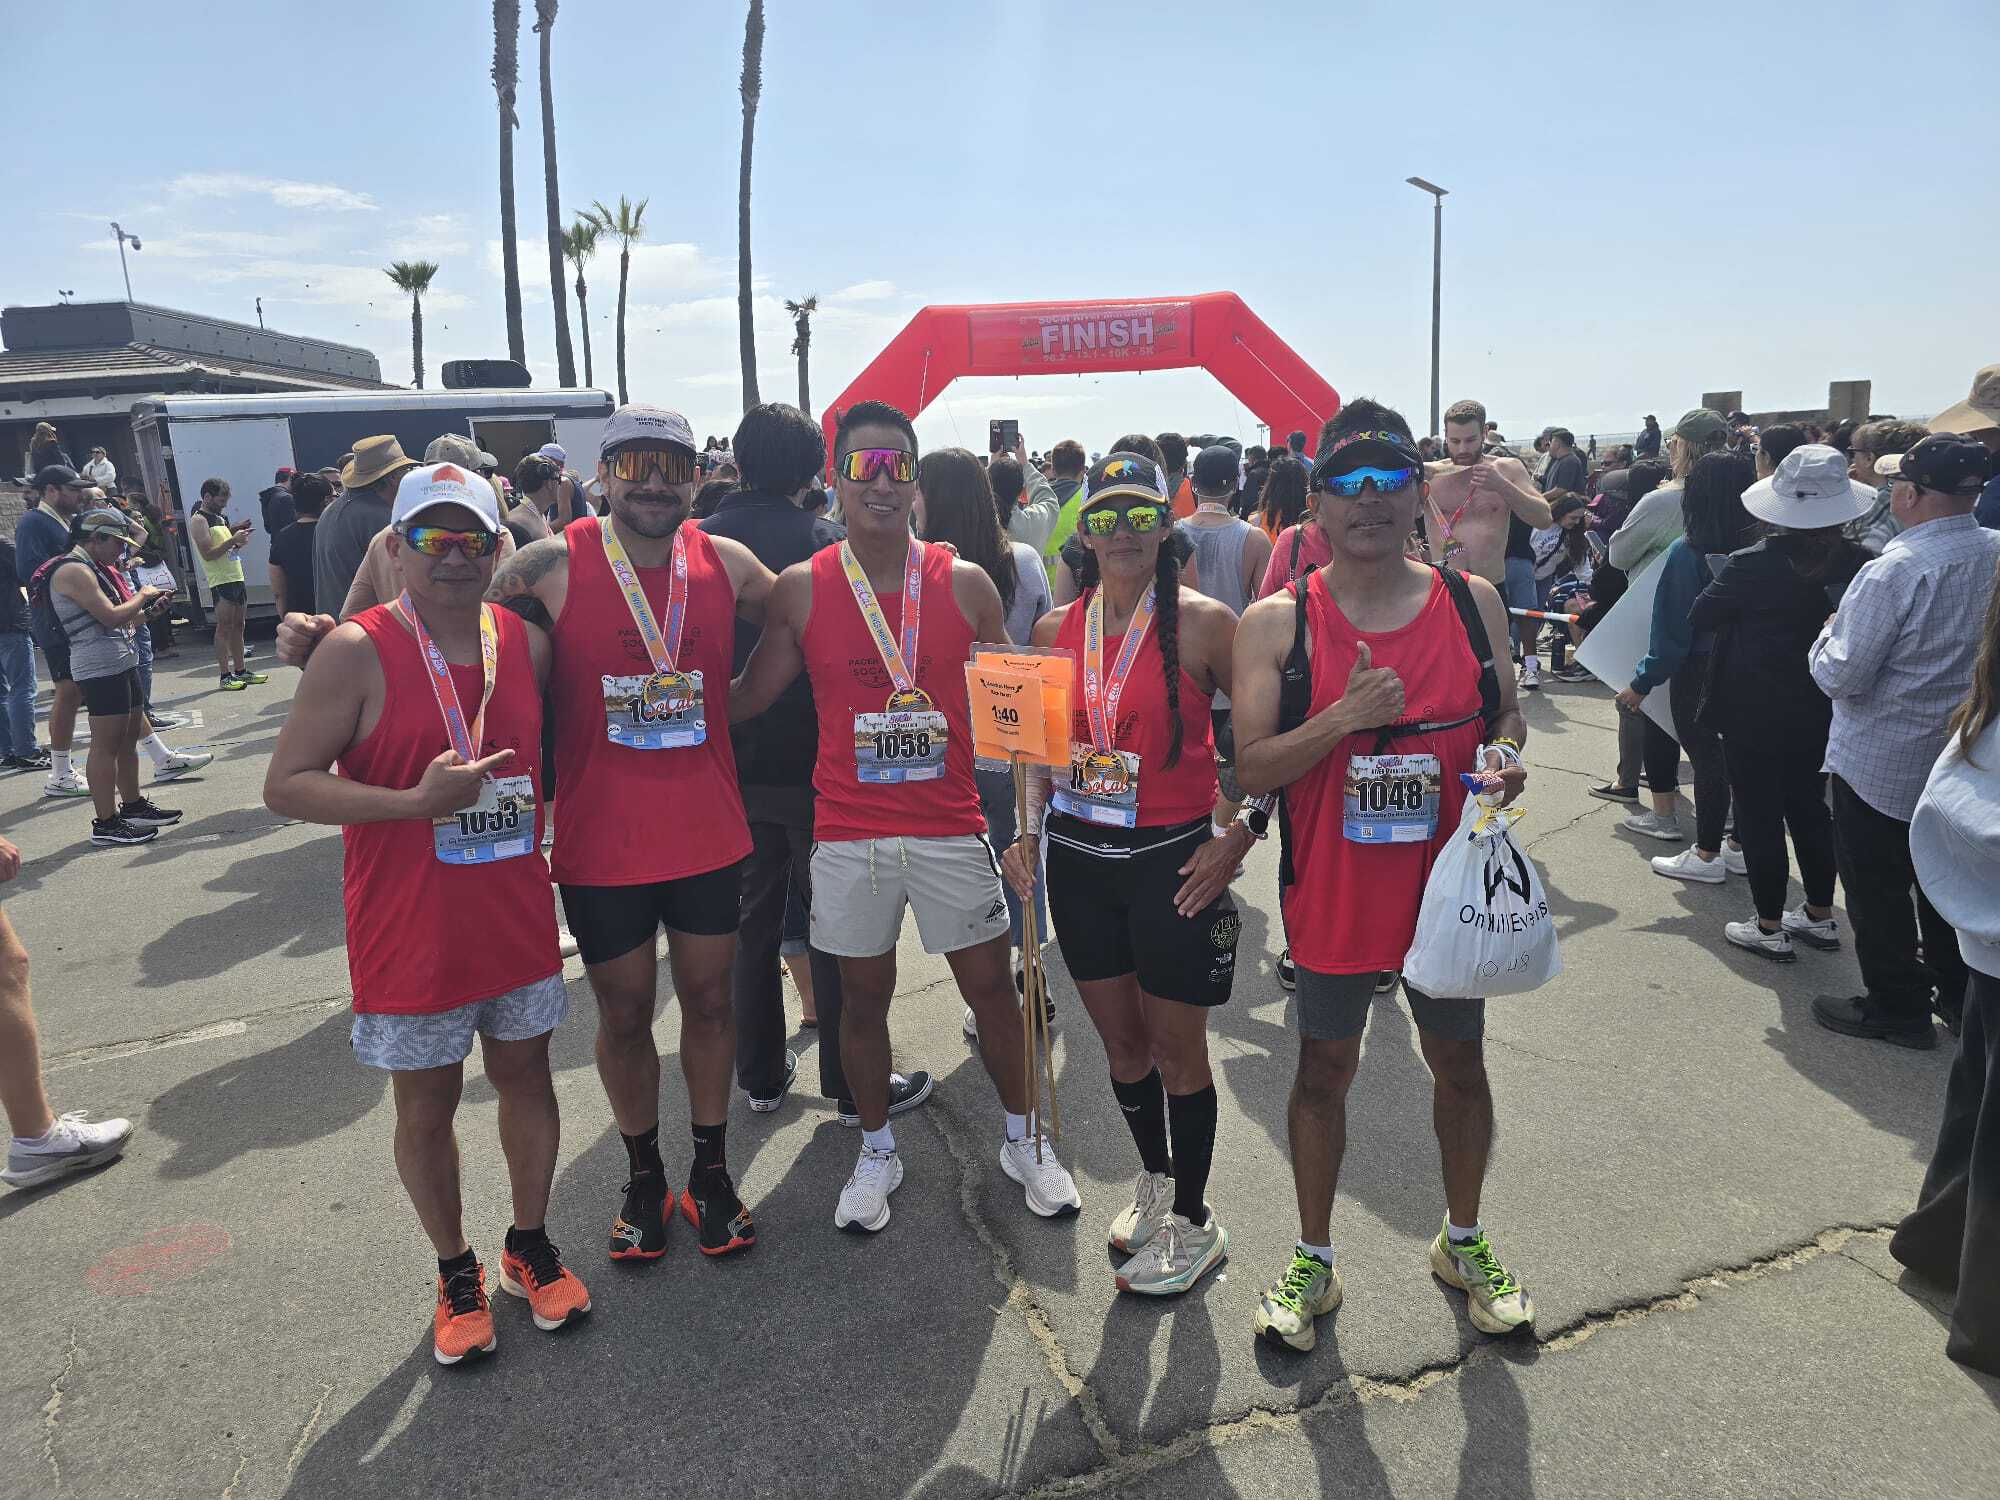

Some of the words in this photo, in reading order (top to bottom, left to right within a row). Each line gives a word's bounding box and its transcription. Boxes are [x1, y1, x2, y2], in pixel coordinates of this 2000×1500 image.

[1041, 318, 1154, 353] FINISH
[991, 704, 1019, 724] 1:40
[873, 732, 931, 760] 1058
[1355, 780, 1424, 812] 1048
[454, 801, 520, 837] 1053
